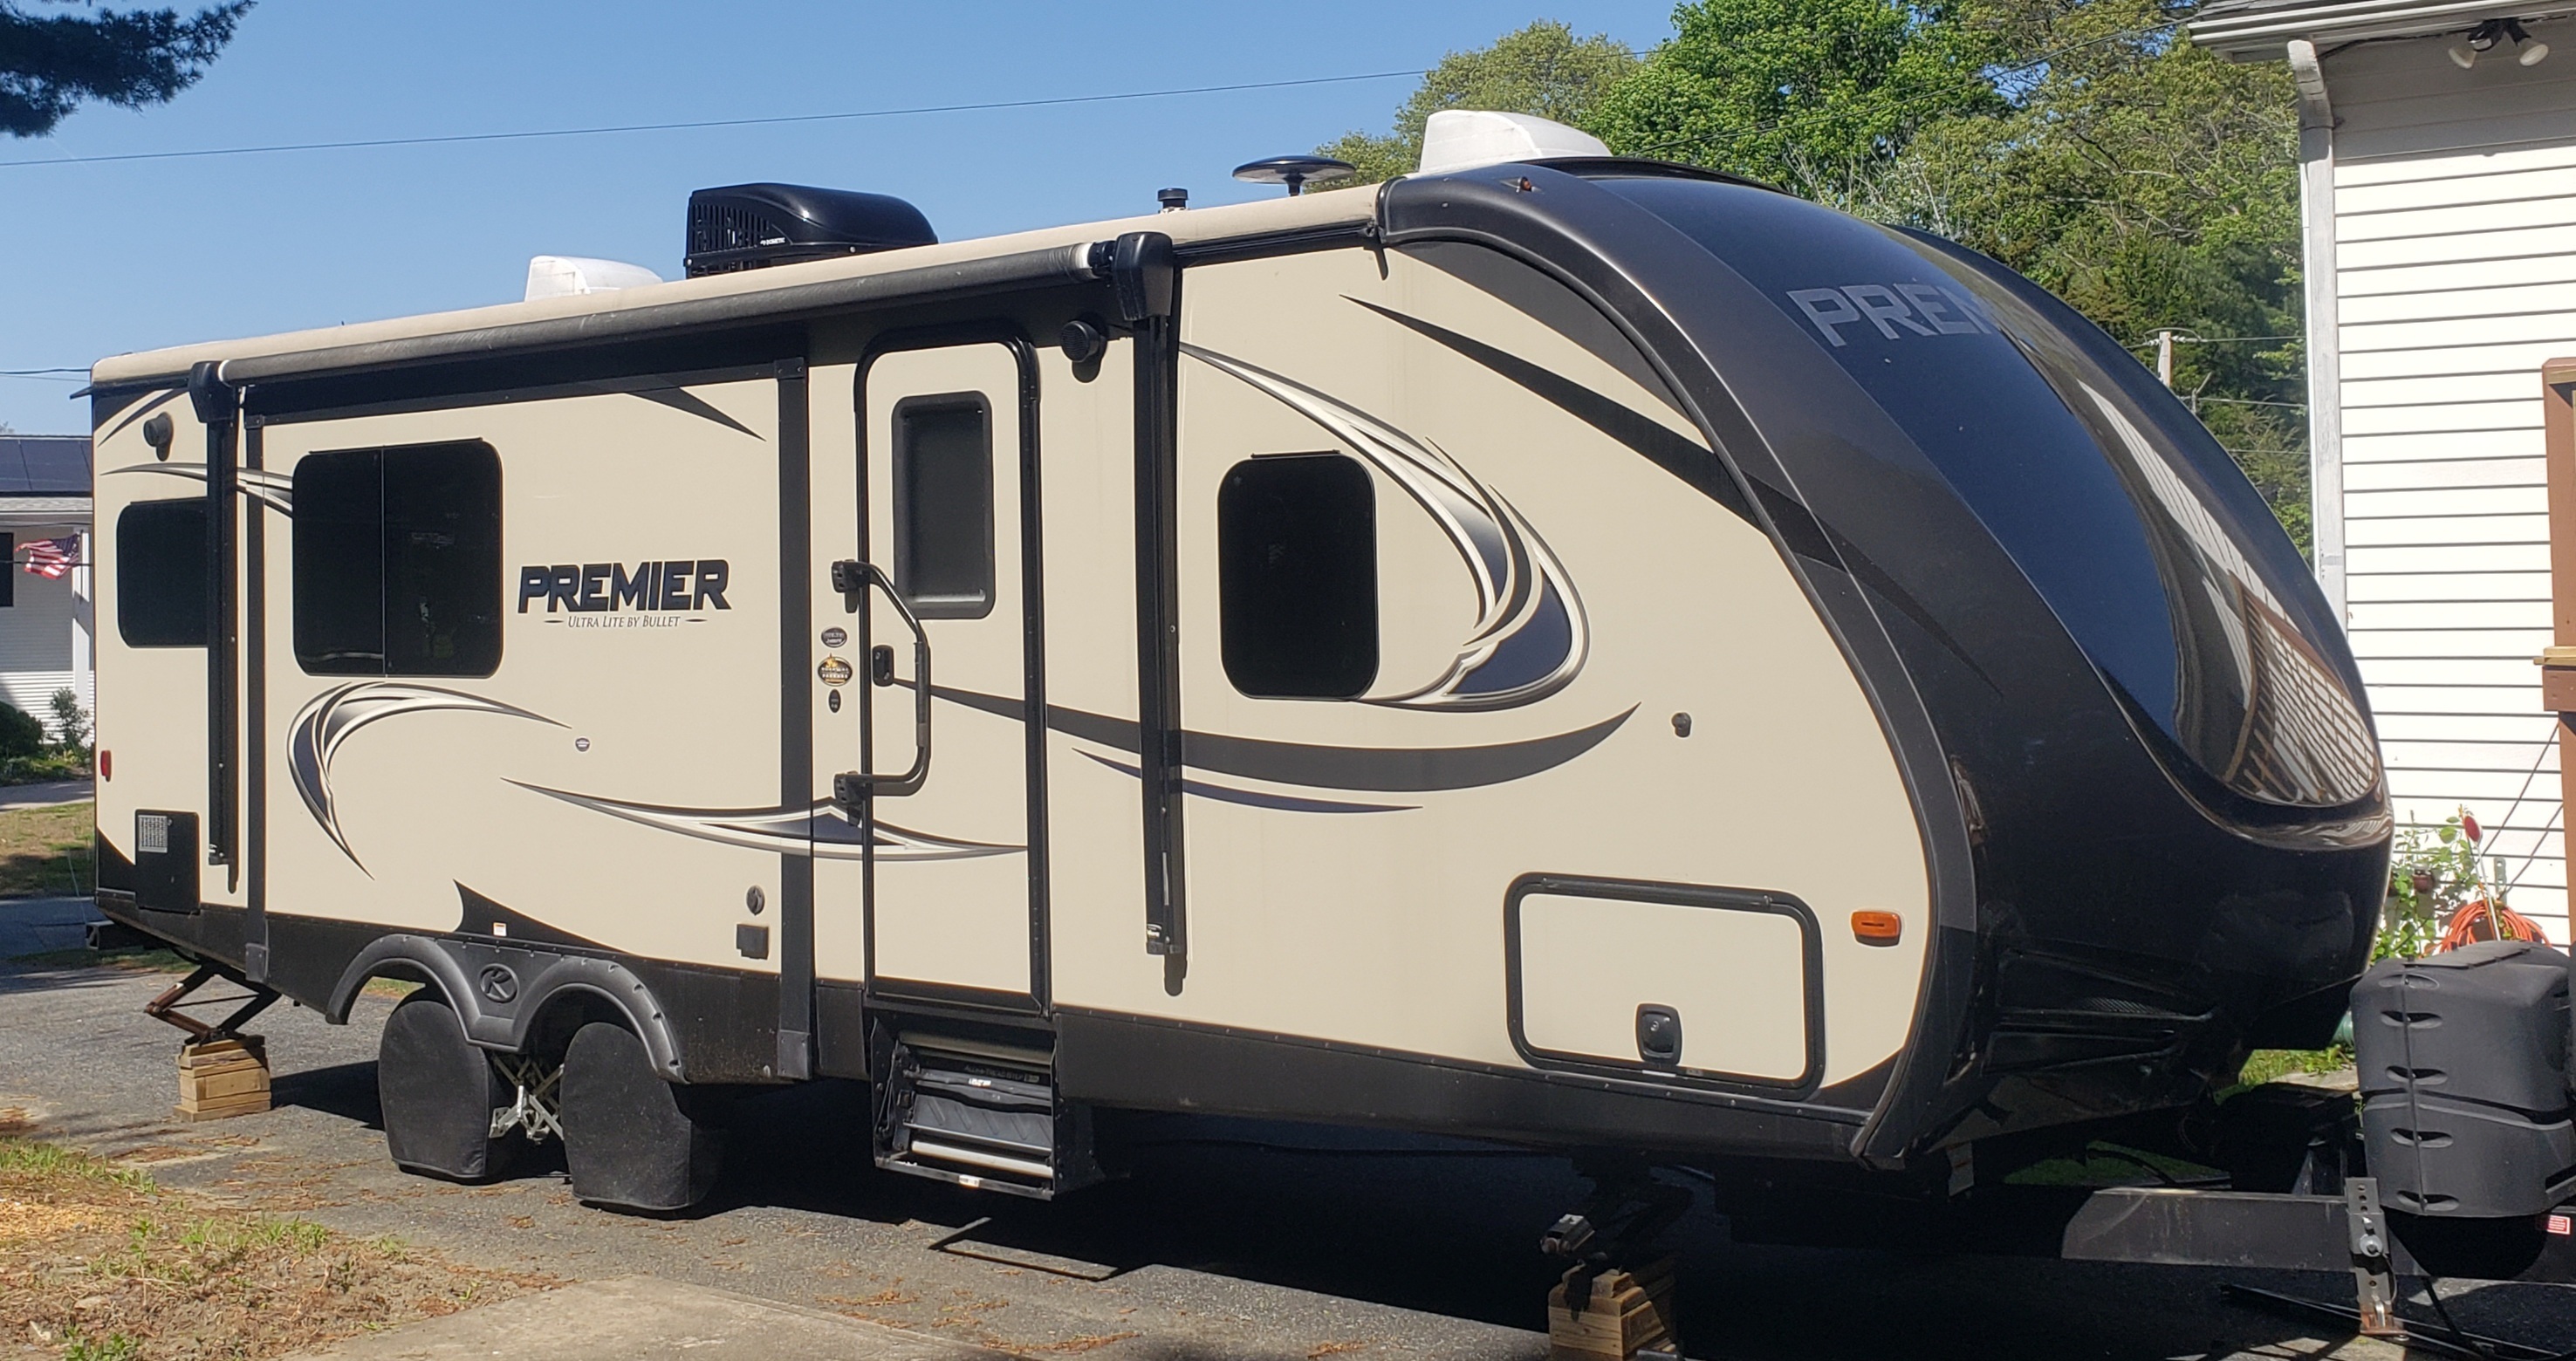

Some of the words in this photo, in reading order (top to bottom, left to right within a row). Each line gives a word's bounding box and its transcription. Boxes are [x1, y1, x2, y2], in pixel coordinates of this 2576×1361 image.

[1786, 284, 1992, 347] PRE
[517, 559, 731, 613] PREMIER
[568, 616, 599, 628] ULTRA
[602, 616, 625, 628] LITE
[627, 617, 641, 628] BY
[642, 615, 681, 627] BULLET
